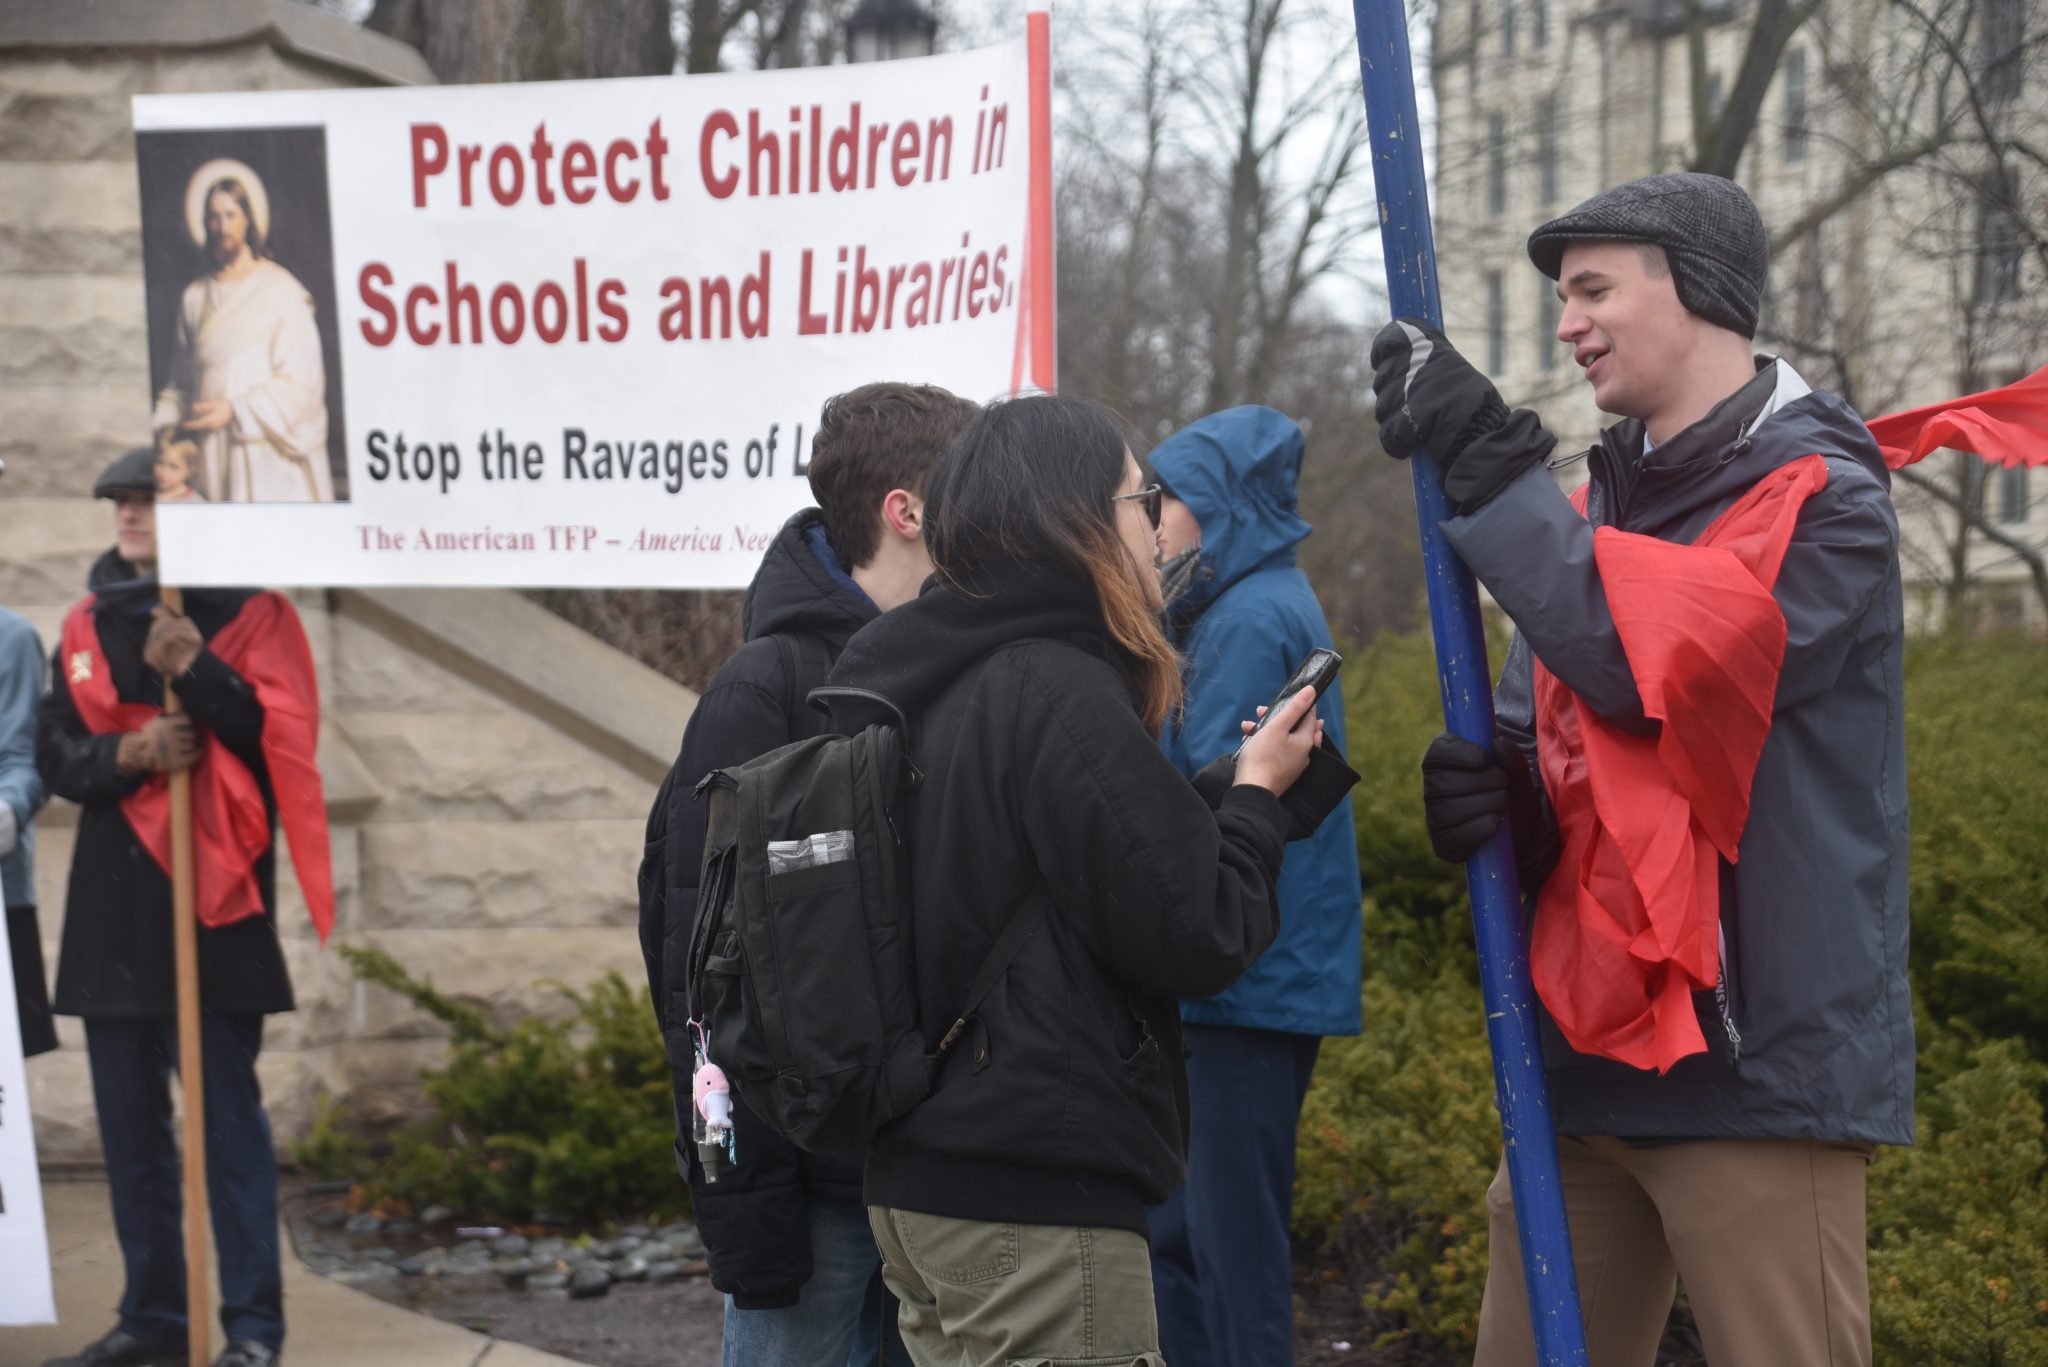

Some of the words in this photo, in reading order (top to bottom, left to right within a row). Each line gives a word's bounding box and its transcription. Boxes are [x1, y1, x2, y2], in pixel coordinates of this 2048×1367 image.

[410, 117, 669, 208] Protect
[699, 102, 952, 200] Children
[972, 85, 1008, 175] in
[358, 259, 629, 347] Schools
[658, 251, 771, 341] and
[366, 429, 461, 494] Stop
[478, 429, 544, 480] the
[563, 427, 728, 494] Ravages
[744, 424, 779, 478] of
[355, 524, 405, 551] The
[414, 525, 535, 551] American
[544, 525, 598, 551] TFP
[629, 525, 722, 552] America
